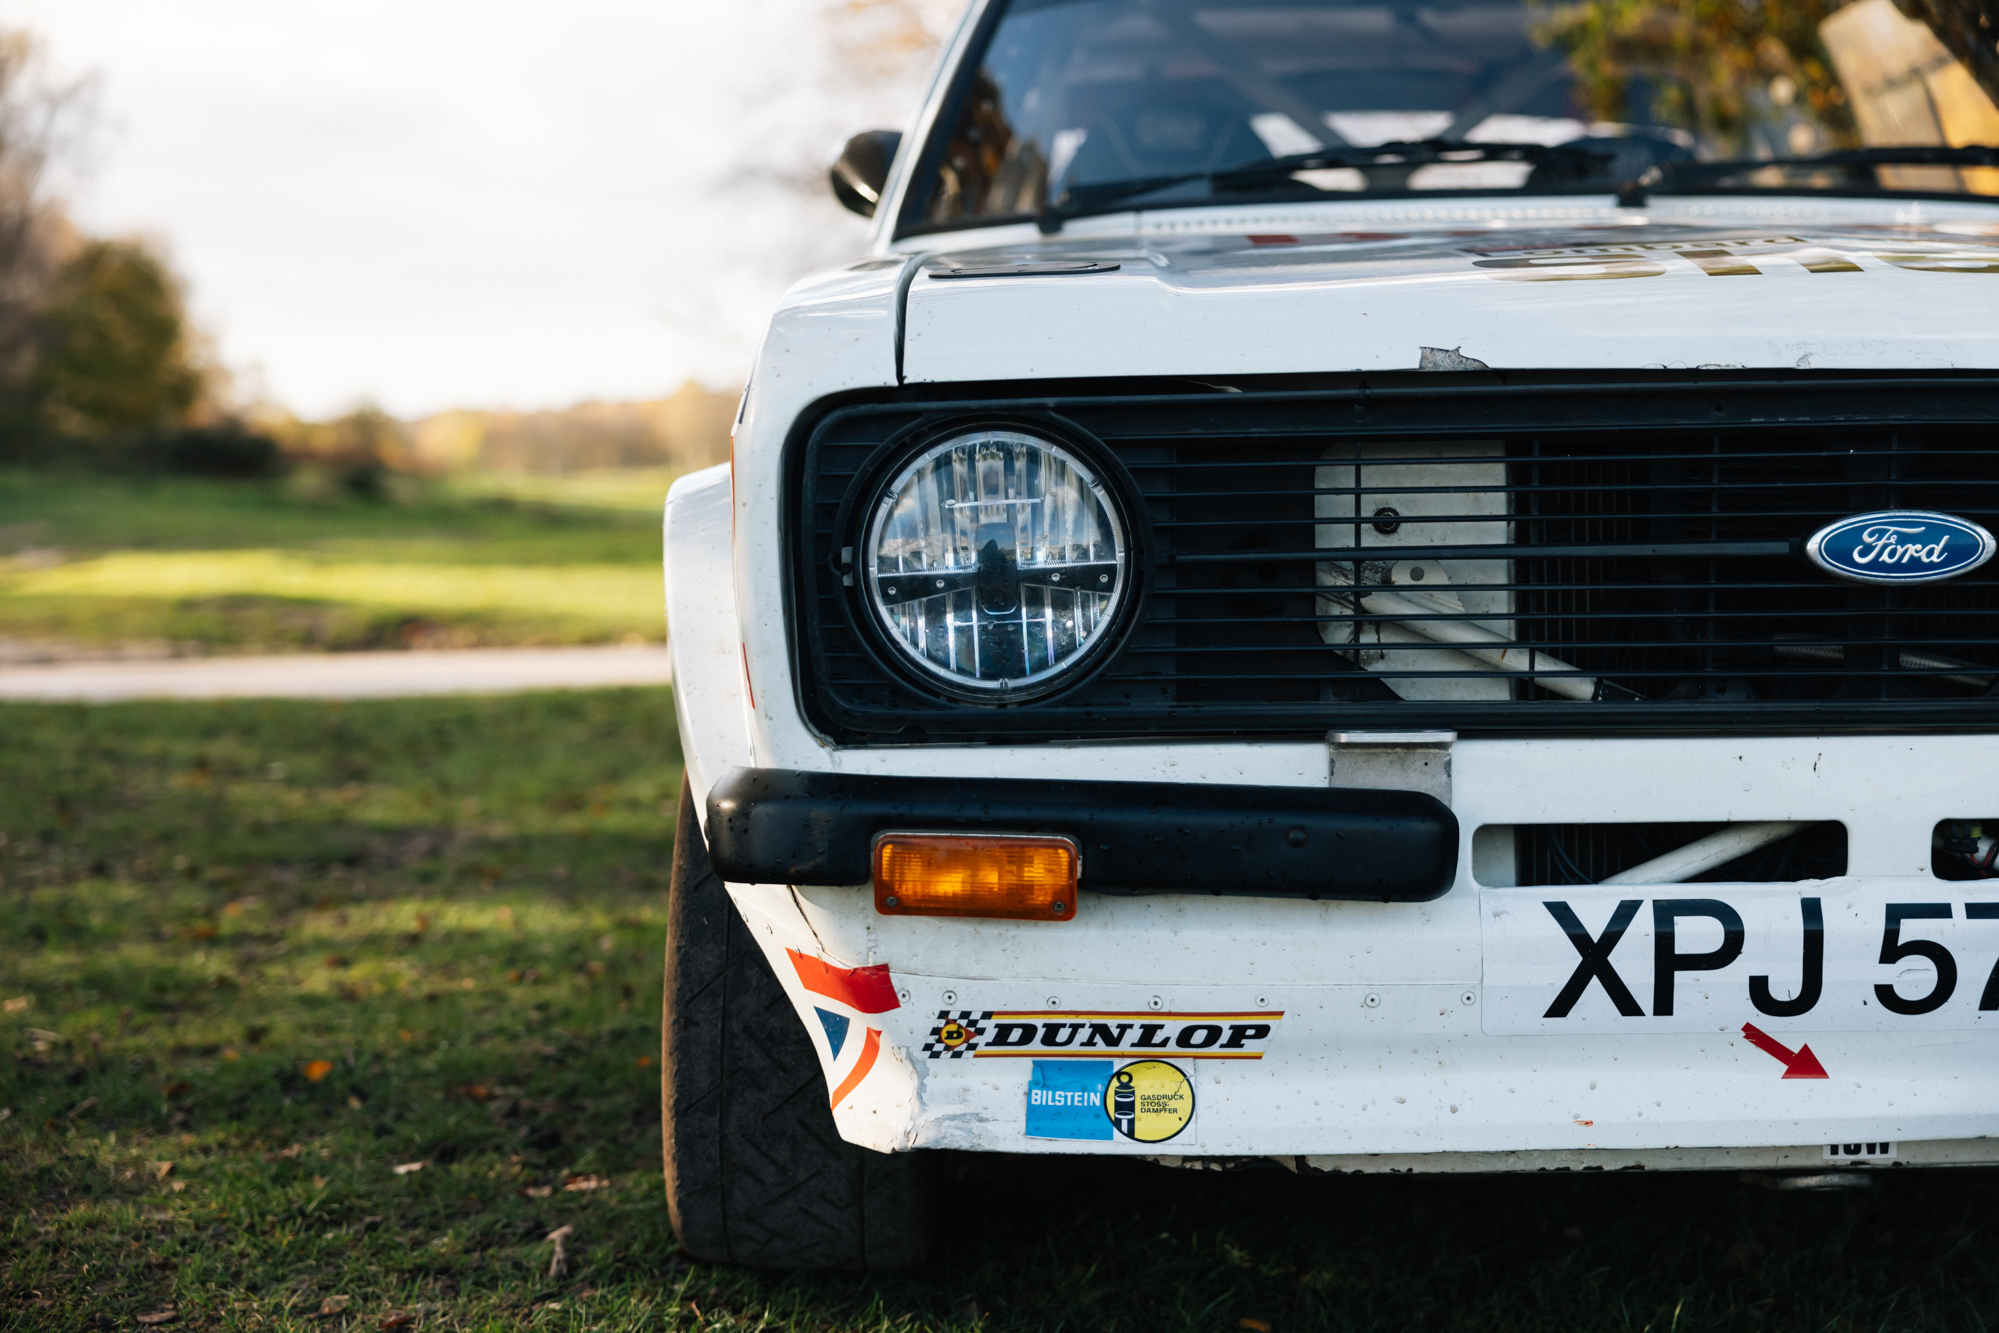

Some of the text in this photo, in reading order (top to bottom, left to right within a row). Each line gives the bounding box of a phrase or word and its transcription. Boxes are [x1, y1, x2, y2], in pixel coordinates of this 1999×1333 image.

[1852, 525, 1950, 564] Ford
[1542, 897, 1824, 1018] XPJ
[984, 1022, 1272, 1049] DUNLOP
